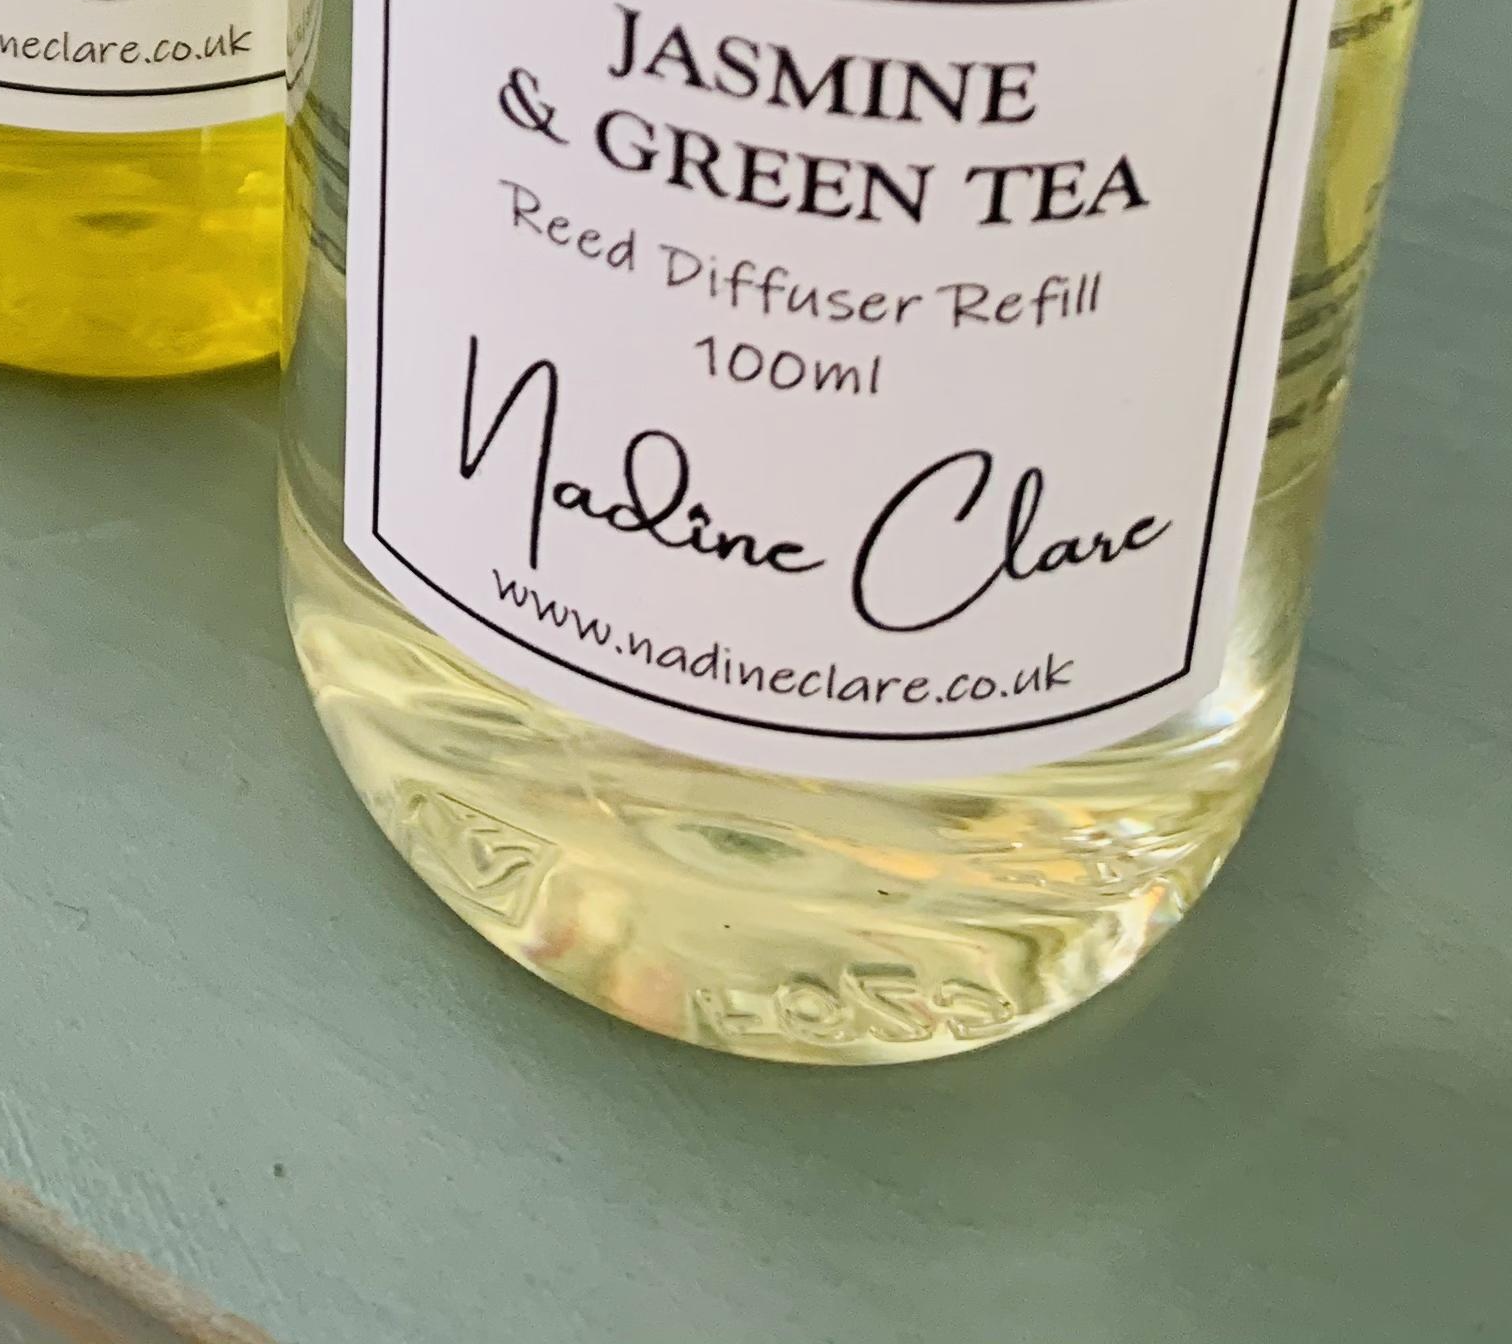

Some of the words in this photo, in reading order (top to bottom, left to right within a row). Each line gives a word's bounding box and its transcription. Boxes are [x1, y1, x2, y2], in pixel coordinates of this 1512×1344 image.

[610, 3, 1038, 127] JASMINE
[497, 66, 569, 144] &
[595, 109, 933, 227] GREEN
[964, 154, 1151, 228] TEA
[498, 179, 637, 273] Reed
[659, 242, 923, 329] Diffuser
[937, 272, 1101, 329] Refill
[694, 336, 883, 397] 100ml
[459, 334, 825, 569] Nadine
[850, 449, 1173, 632] Clare
[493, 568, 1074, 706] www.nadineclare.co.uk
